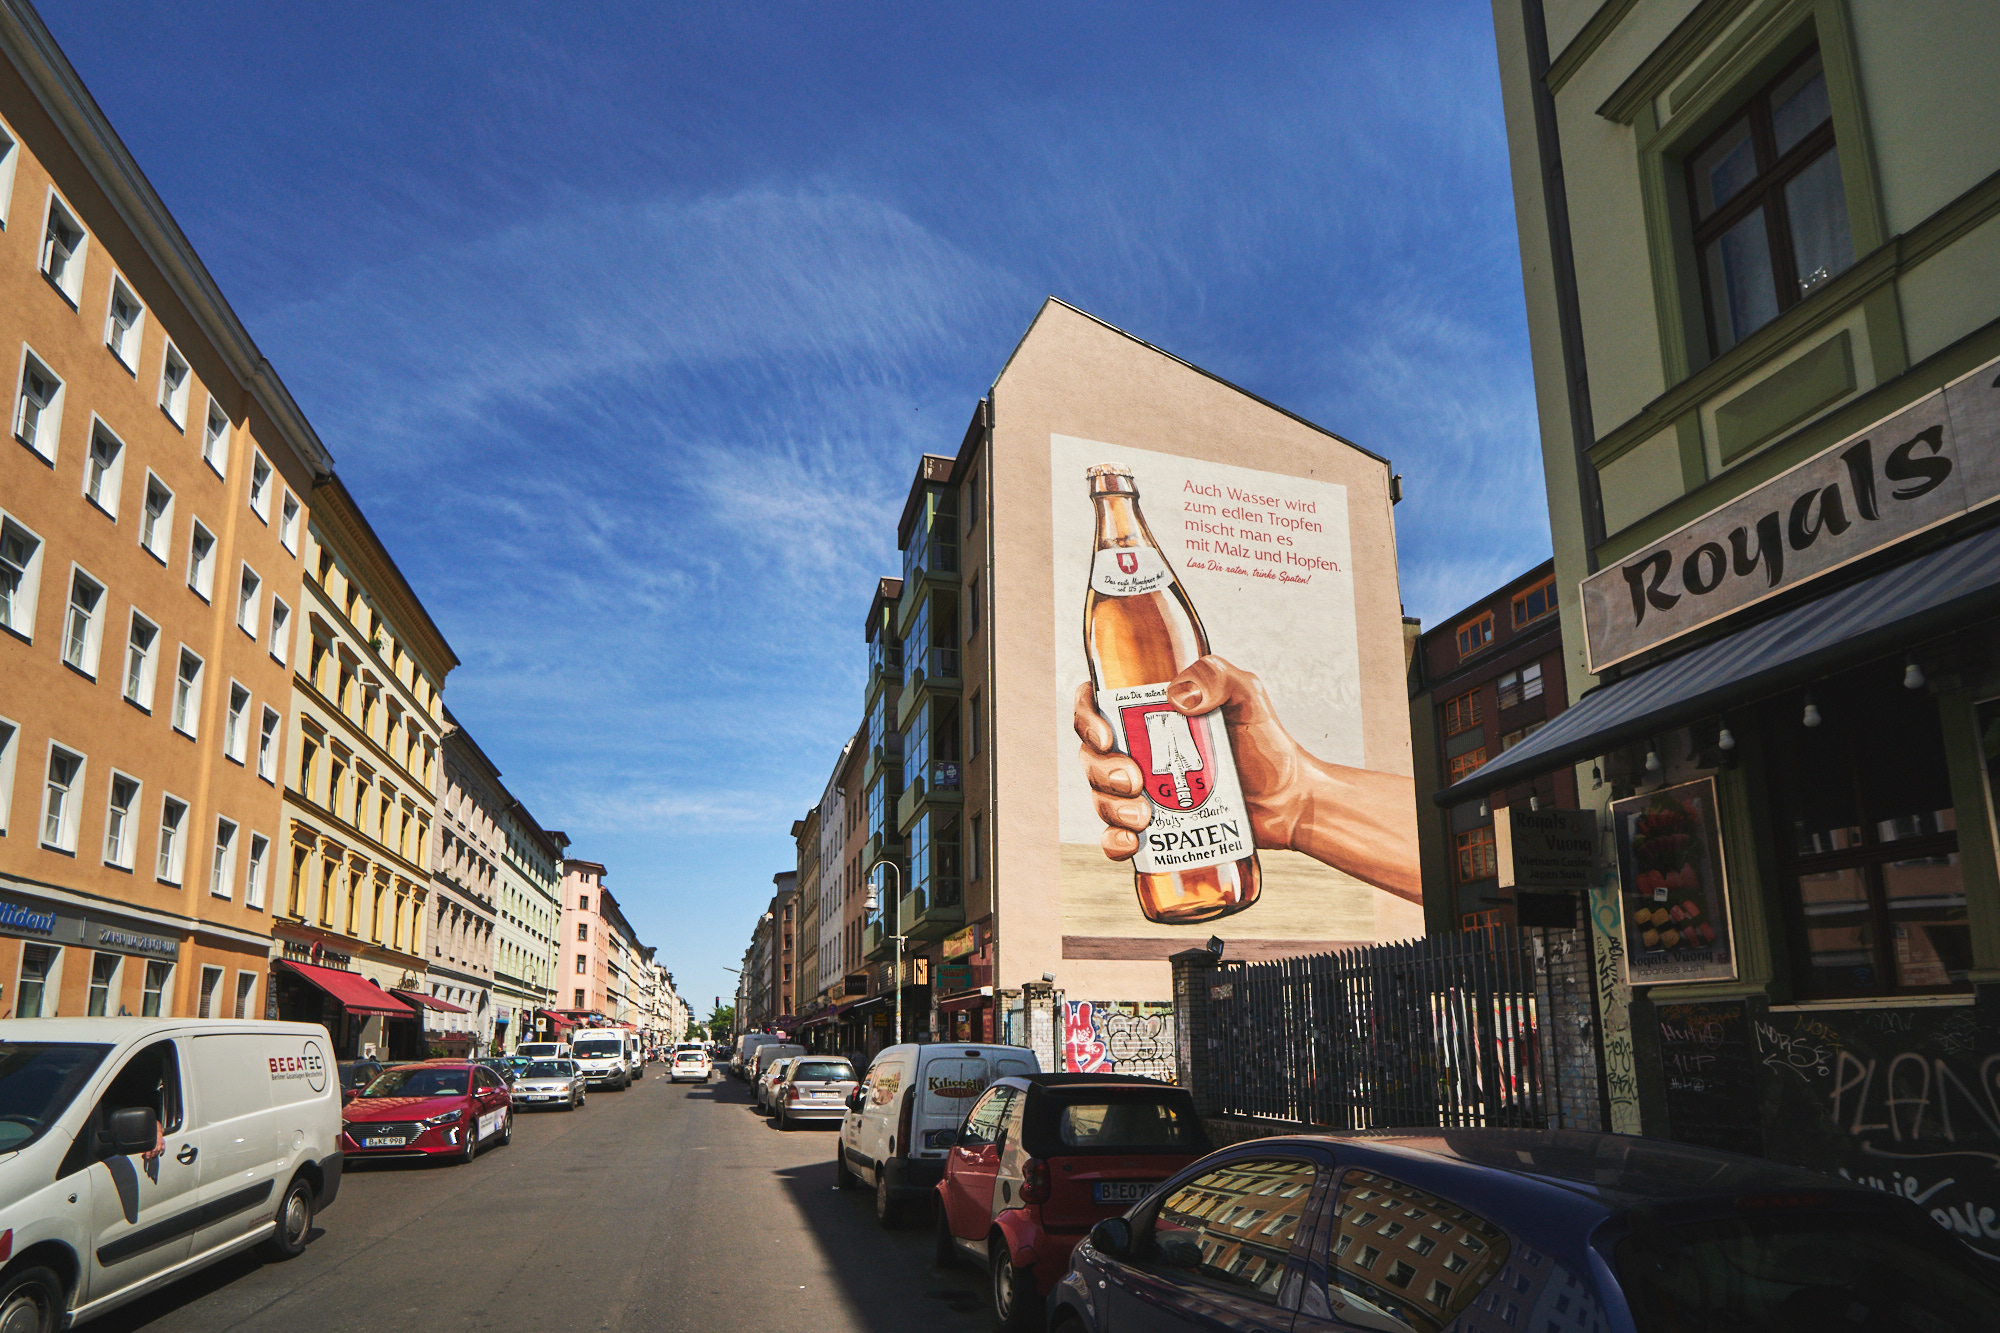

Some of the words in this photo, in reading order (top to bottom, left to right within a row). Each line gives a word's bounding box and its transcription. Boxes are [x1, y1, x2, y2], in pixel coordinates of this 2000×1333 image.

[1183, 480, 1222, 498] Auch
[1227, 486, 1280, 508] Wasser
[1284, 499, 1316, 513] wird
[1184, 501, 1216, 515] zum
[1221, 507, 1263, 523] edlen
[1267, 512, 1322, 533] Tropfen
[1622, 424, 1953, 629] Royals
[1185, 520, 1235, 537] mischt
[1240, 529, 1272, 543] man
[1276, 535, 1293, 546] es
[1186, 538, 1210, 552] mit
[1214, 540, 1250, 559] Malz
[1254, 550, 1282, 564] und
[1286, 551, 1342, 572] Hopfen.
[1186, 557, 1205, 569] Lass
[1207, 559, 1223, 572] Dir
[1225, 566, 1249, 577] raten,
[1252, 568, 1276, 580] trinke
[1278, 571, 1311, 585] Spaten!
[1195, 778, 1205, 789] S
[1516, 812, 1566, 832] Royals
[1149, 819, 1240, 852] SPATEN
[1154, 848, 1216, 866] Münchner
[1219, 841, 1243, 855] Hell
[1545, 836, 1592, 856] Vuong
[1520, 856, 1559, 867] Vietnam
[1528, 869, 1558, 880] Japan
[1559, 869, 1586, 880] Sushi
[1673, 951, 1713, 965] Vuong
[1637, 965, 1681, 977] japanese
[1682, 963, 1706, 974] sushi
[269, 1056, 322, 1073] BEGATEC
[1102, 1184, 1111, 1198] B
